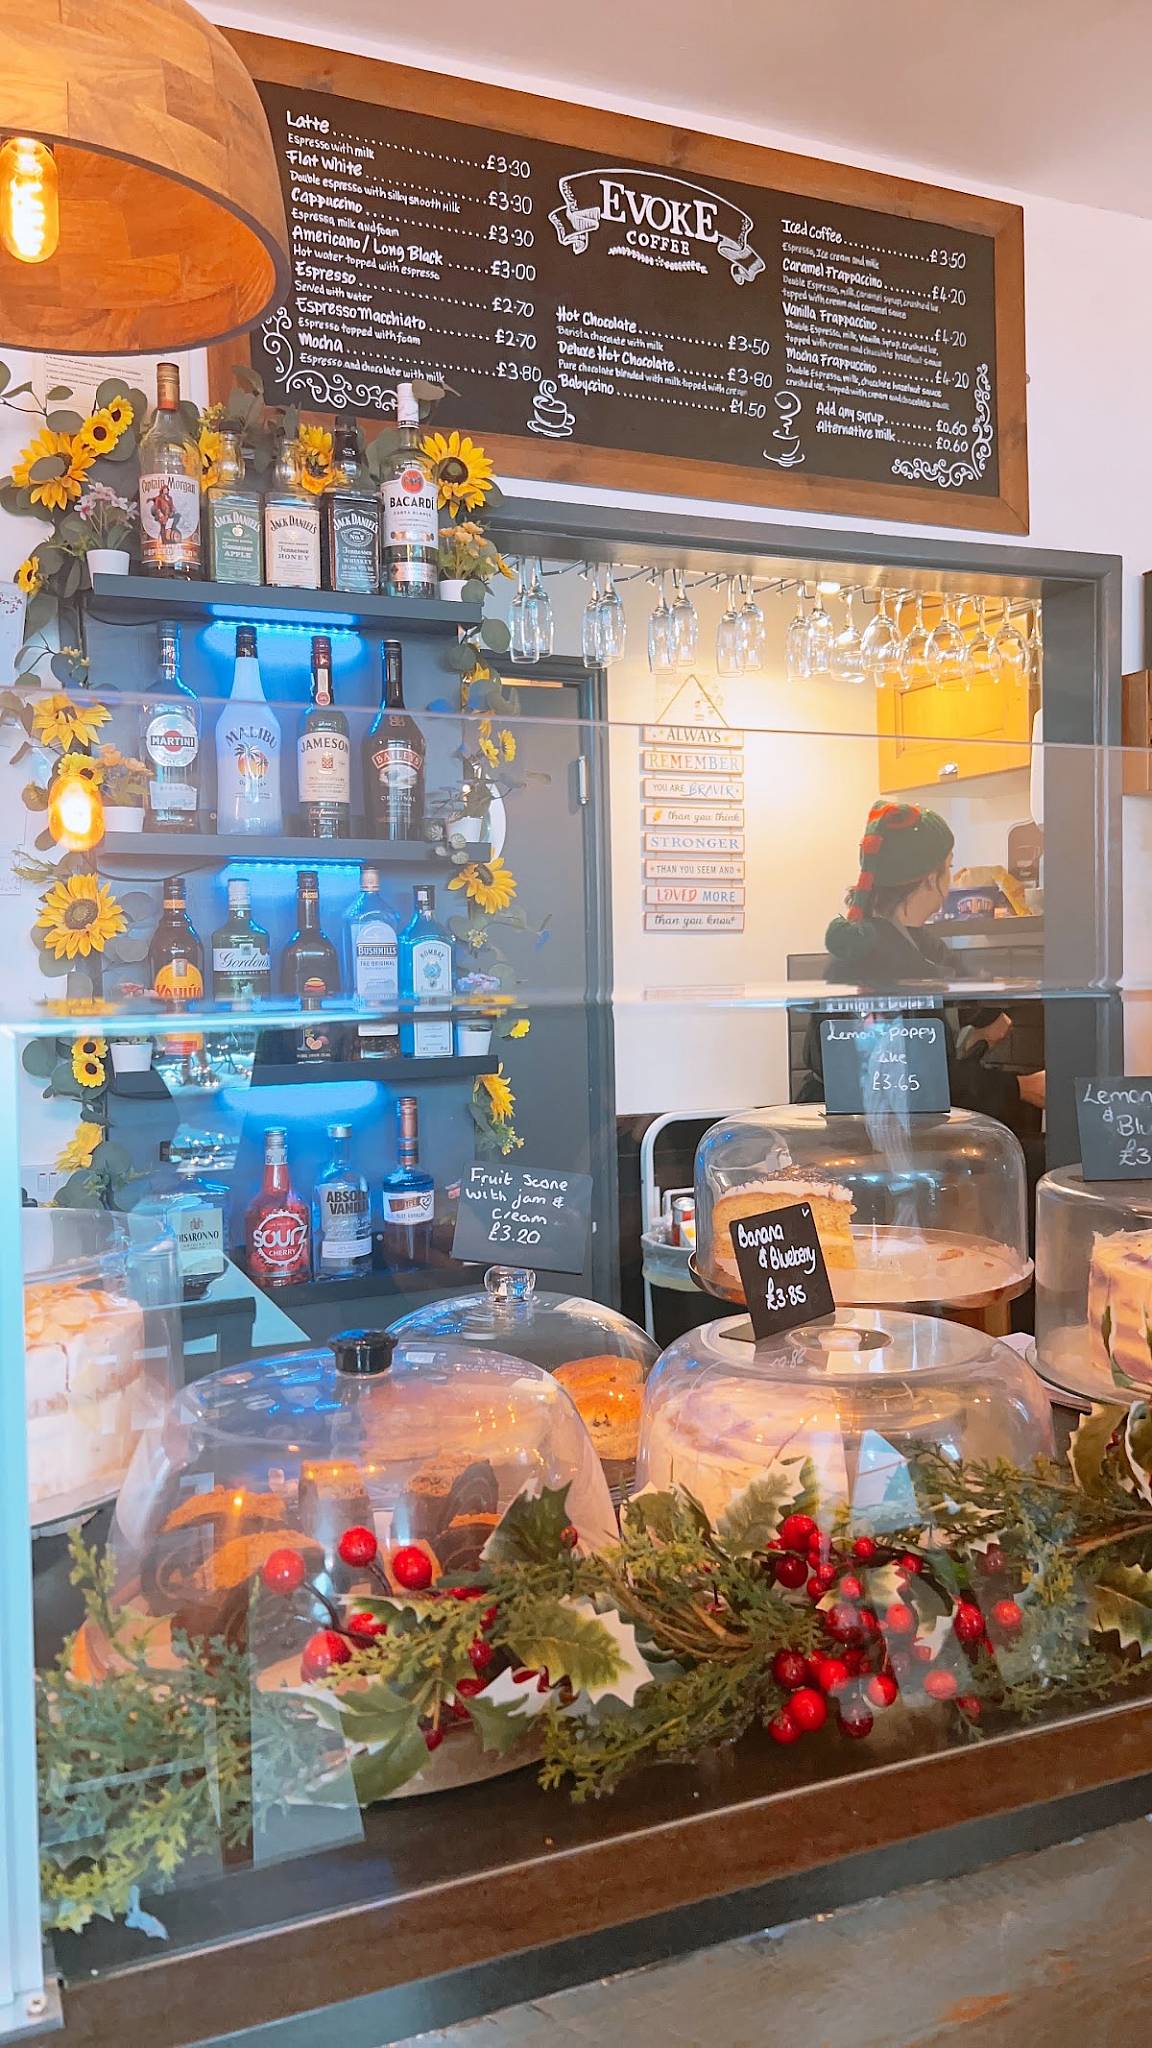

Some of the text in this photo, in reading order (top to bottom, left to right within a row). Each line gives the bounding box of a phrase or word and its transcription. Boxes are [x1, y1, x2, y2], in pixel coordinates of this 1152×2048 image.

[286, 110, 531, 179] Latte £3.30
[288, 132, 375, 160] Espresso with milk
[286, 150, 533, 215] Flat White £3.30
[290, 170, 321, 186] Double
[322, 178, 363, 194] espresso
[364, 186, 386, 199] with
[388, 189, 408, 206] silky
[292, 187, 534, 248] Cappuccino £3.30
[599, 179, 719, 243] EVOKE
[338, 217, 356, 229] milk
[376, 224, 399, 237] foam
[292, 225, 536, 281] Americano / Long Black £3.00
[626, 230, 690, 256] COFFEE
[782, 220, 966, 269] Iced Coffee £3.50
[294, 244, 440, 281] Hot water topped with espresso
[294, 280, 373, 303] Served with water
[295, 261, 535, 318] Espresso £2.70
[783, 258, 824, 277] Caramel
[932, 286, 966, 306] £4.20
[296, 298, 536, 350] Espresso Macchiato £2.70
[298, 317, 421, 345] Espresso topped with foam
[556, 306, 770, 356] Hot Chocolate £3.50
[782, 302, 816, 320] Vanilla
[935, 328, 967, 347] £4.20
[556, 326, 664, 351] Barista chocolate with milk
[298, 332, 542, 382] Mocha £3.80
[300, 352, 445, 383] Espresso and chocolate with milk
[557, 341, 773, 389] Deluxe Hot Chocolate £3.80
[786, 348, 819, 365] Mocha
[935, 370, 970, 390] £4.20
[558, 359, 577, 371] Pure
[578, 362, 614, 376] chocolate
[644, 374, 663, 384] with
[558, 374, 766, 419] Babyccino £1.50
[816, 401, 967, 436] Add any syrup £0.60
[816, 420, 969, 453] Alternative milk £0.60
[168, 476, 196, 494] Morgan
[214, 513, 233, 528] JACK
[270, 518, 288, 532] JACK
[334, 516, 352, 531] JACK
[152, 736, 194, 747] MARTINI
[226, 726, 278, 749] MALIBU
[301, 738, 349, 754] JAMESON
[667, 728, 721, 743] ALWAYS
[376, 750, 419, 765] BAILEYS
[650, 754, 739, 770] REMEMBER
[654, 784, 668, 792] YOU
[670, 784, 685, 793] ARE
[650, 836, 739, 849] STRONGER
[656, 865, 735, 874] THAN YOU SEEM AND
[658, 888, 736, 902] LOVED MORE
[654, 914, 736, 928] than you know
[358, 946, 397, 956] BUSHMILLS
[420, 948, 445, 960] BOMBAY
[827, 1020, 876, 1040] Lemon
[872, 1072, 920, 1091] £3.65
[1083, 1084, 1152, 1105] Lemon
[470, 1167, 513, 1187] Fruit
[466, 1188, 565, 1210] with jam &
[488, 1222, 541, 1245] £3.20
[738, 1223, 785, 1248] Banana
[269, 1248, 296, 1257] CHERRY
[766, 1276, 807, 1311] £3.85
